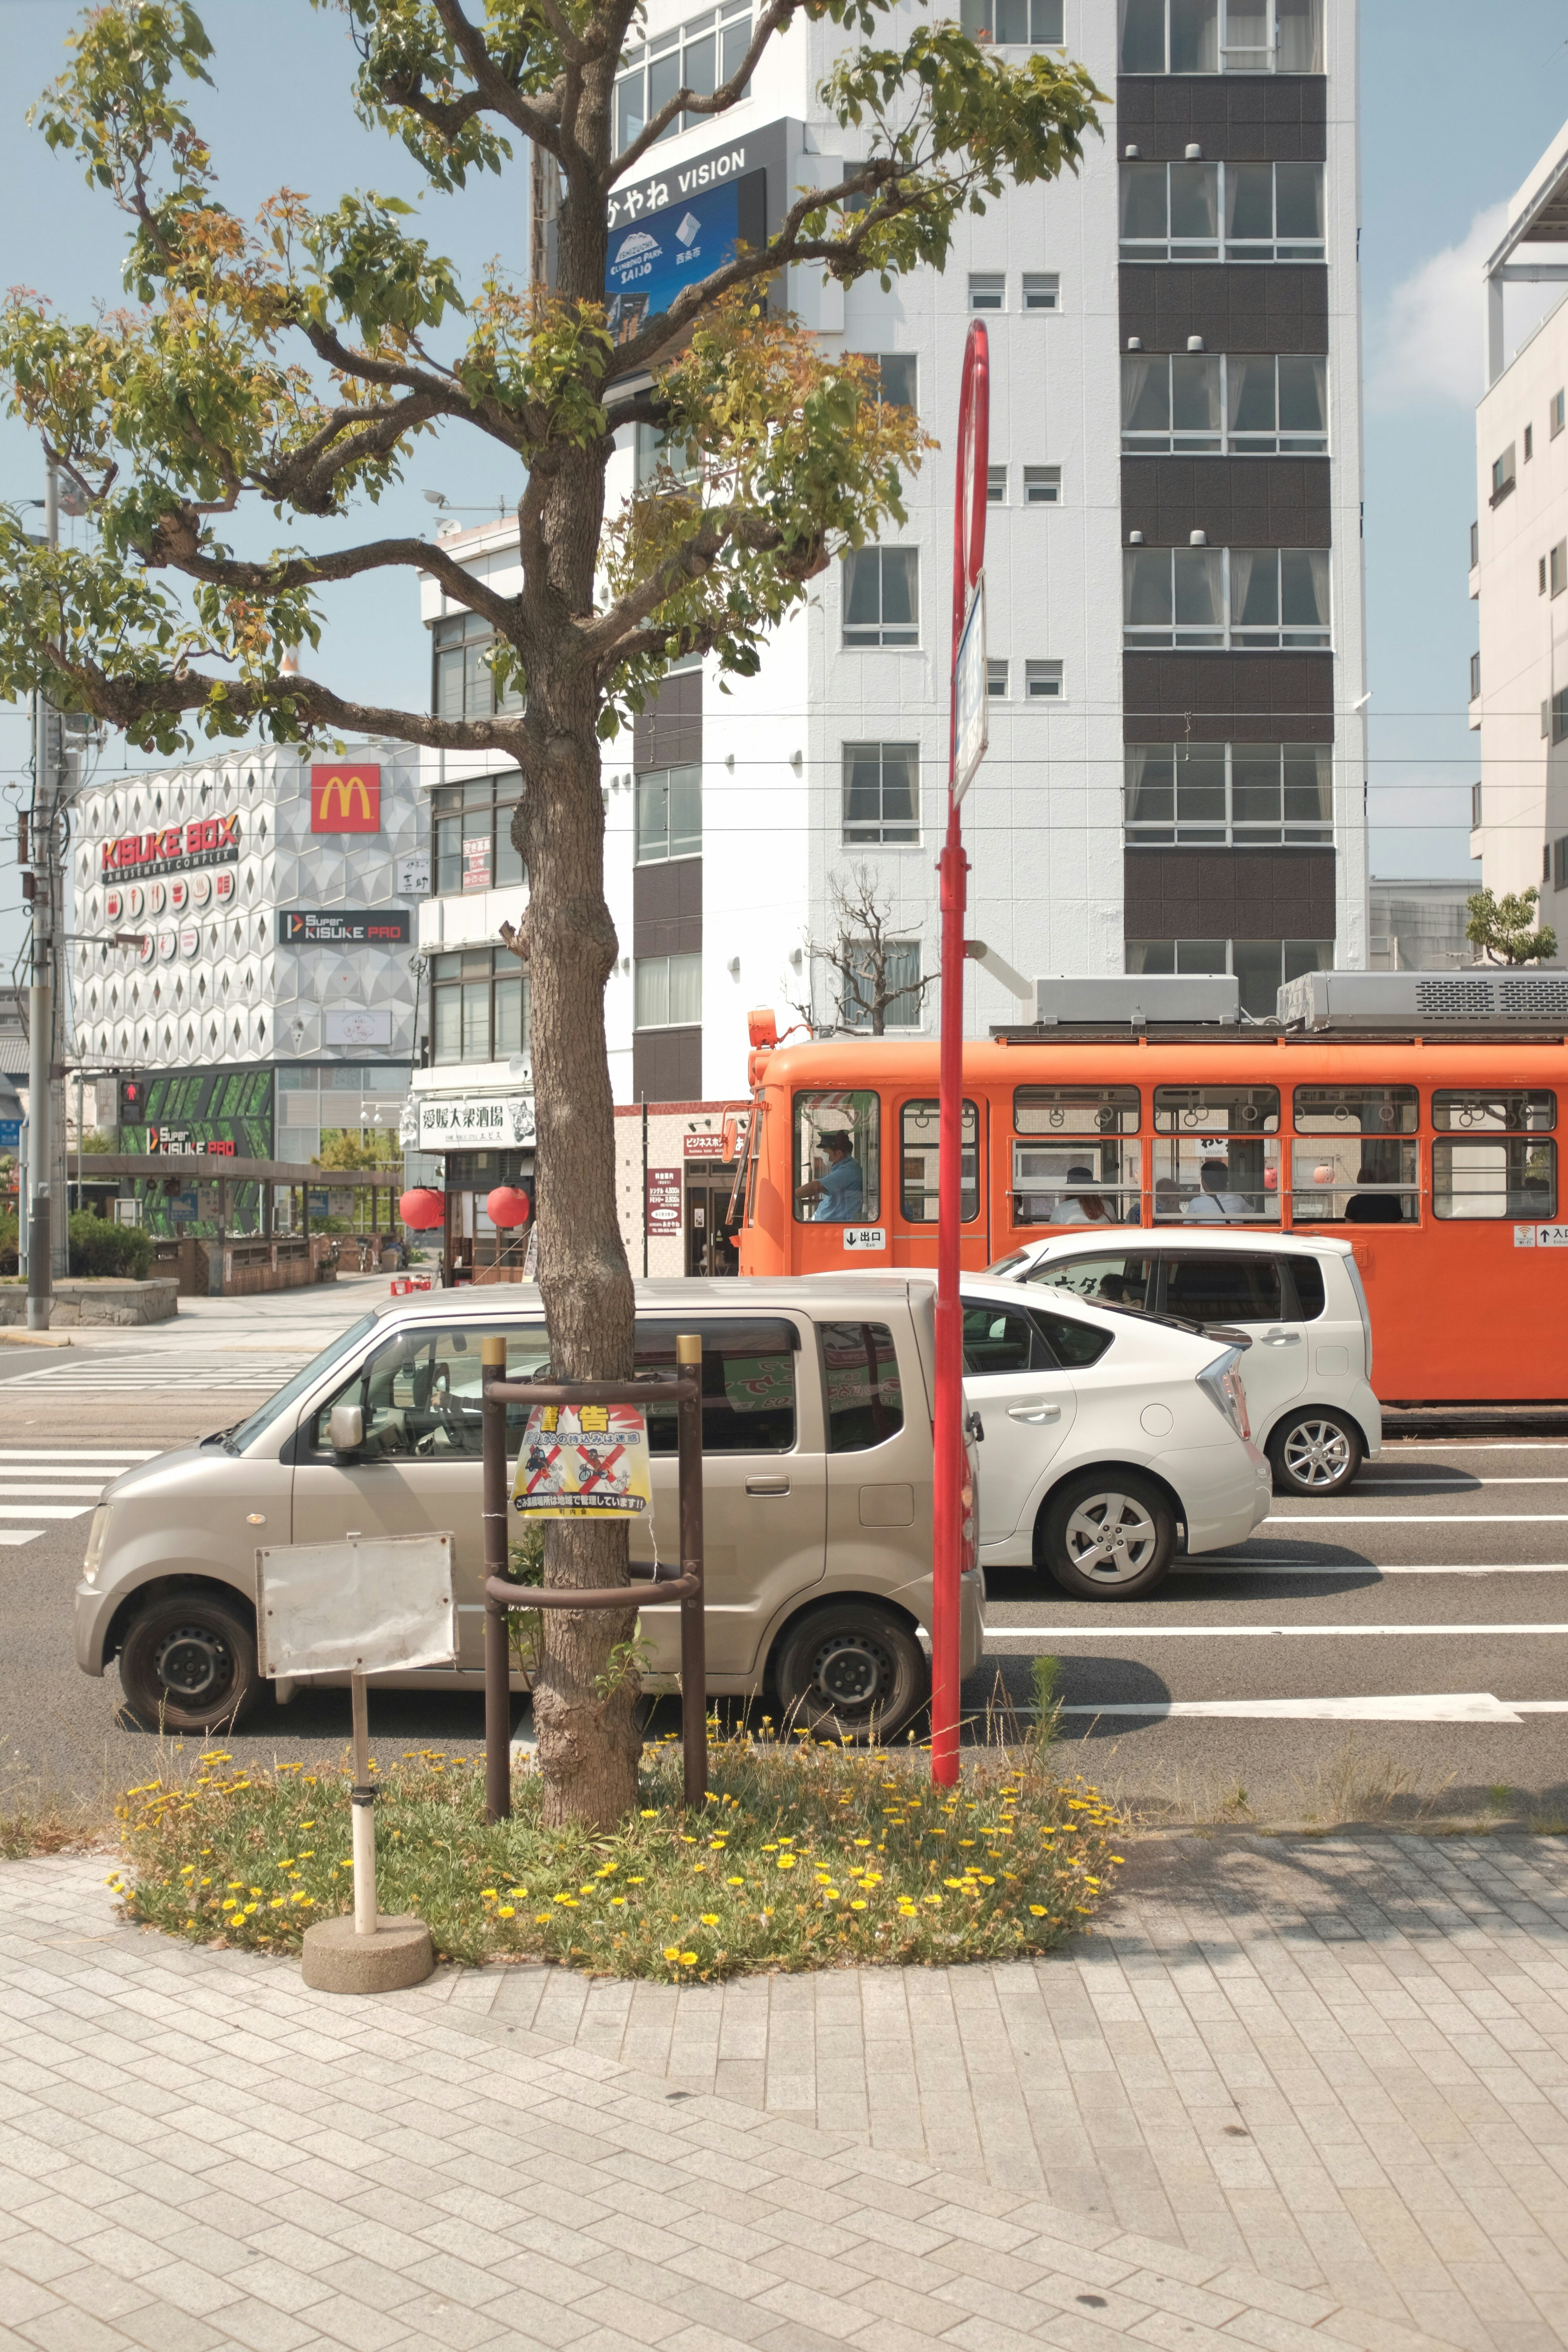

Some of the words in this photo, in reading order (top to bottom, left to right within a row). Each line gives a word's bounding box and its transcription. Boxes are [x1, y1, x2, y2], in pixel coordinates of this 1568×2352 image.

[678, 148, 745, 193] VISION
[643, 247, 663, 262] PARK
[676, 247, 701, 265] 西条市
[621, 262, 652, 284] SAIJO
[103, 826, 182, 870] KISUKE
[187, 815, 238, 853] BOX
[108, 861, 172, 882] AMUSEMENT
[176, 850, 229, 869] COMPLEX
[305, 927, 364, 939] KISUKE
[160, 1141, 205, 1156] KISUKE
[861, 1232, 880, 1241] 出口
